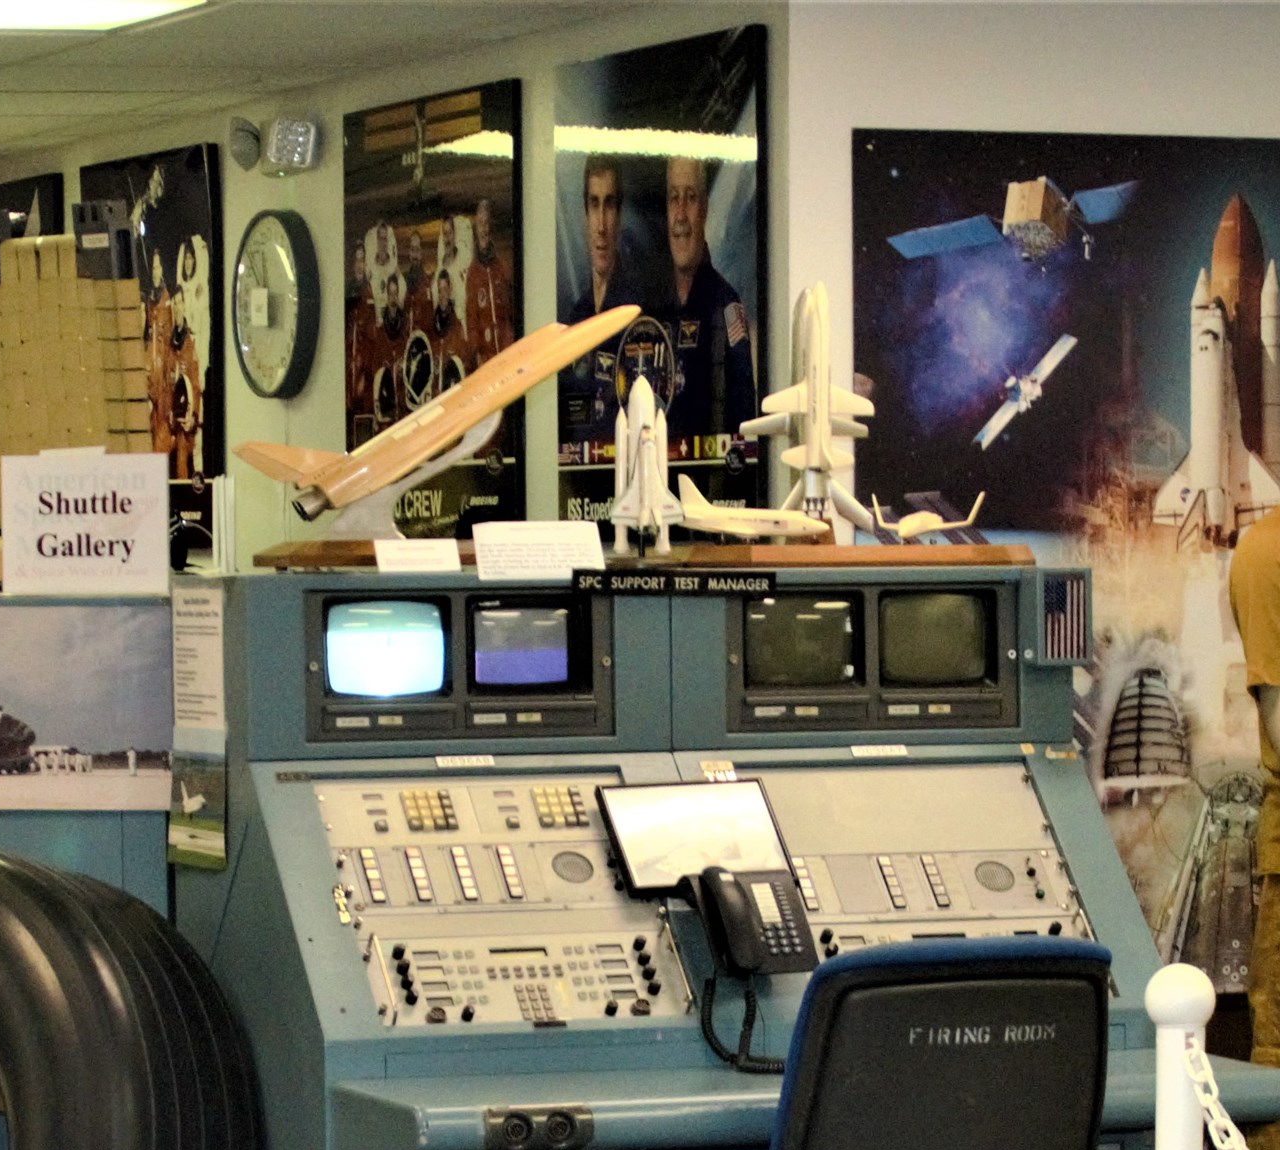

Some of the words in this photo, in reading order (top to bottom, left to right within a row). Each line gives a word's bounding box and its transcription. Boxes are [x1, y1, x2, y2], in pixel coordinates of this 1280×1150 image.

[38, 490, 133, 516] Shuttle
[404, 489, 443, 518] CREW
[567, 497, 582, 519] ISS
[584, 497, 615, 519] Expedi
[36, 532, 135, 564] Gallery
[578, 575, 602, 589] SPC
[610, 576, 666, 590] SUPPORT
[674, 576, 700, 590] TEST
[707, 577, 770, 591] MANAGER
[908, 1026, 991, 1045] FIRING
[1004, 1023, 1058, 1043] ROOM
